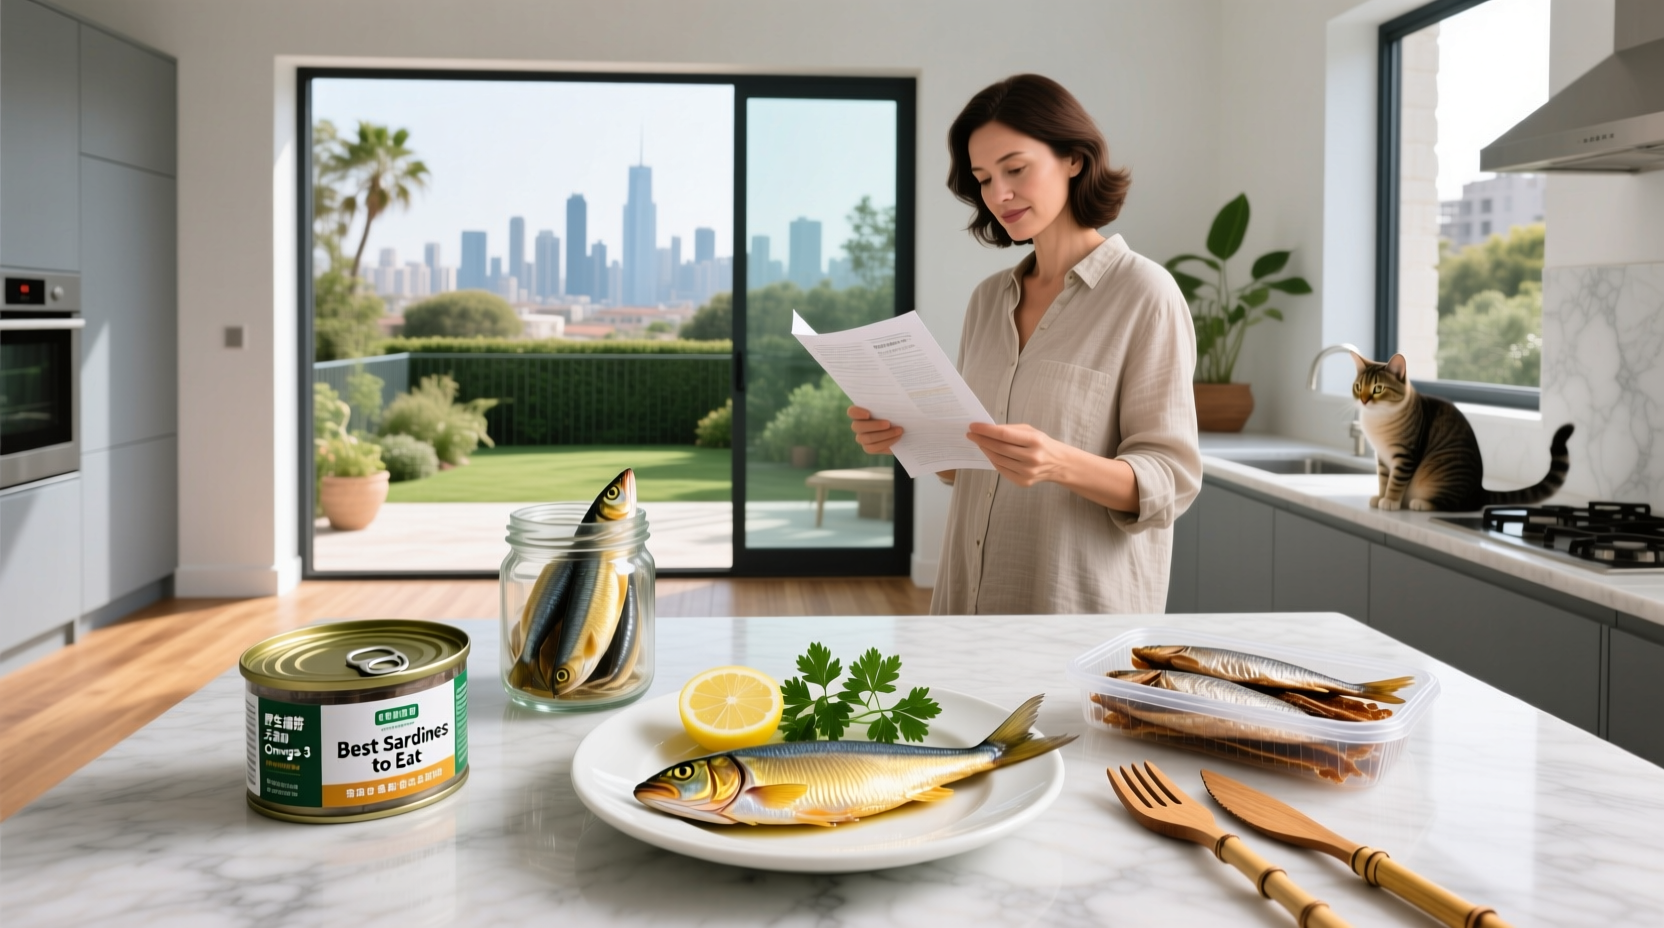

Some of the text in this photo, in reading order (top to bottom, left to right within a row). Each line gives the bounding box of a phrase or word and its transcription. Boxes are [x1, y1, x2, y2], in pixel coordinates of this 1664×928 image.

[337, 739, 379, 758] Best
[383, 723, 449, 752] Sardines
[372, 749, 423, 773] to Eat
